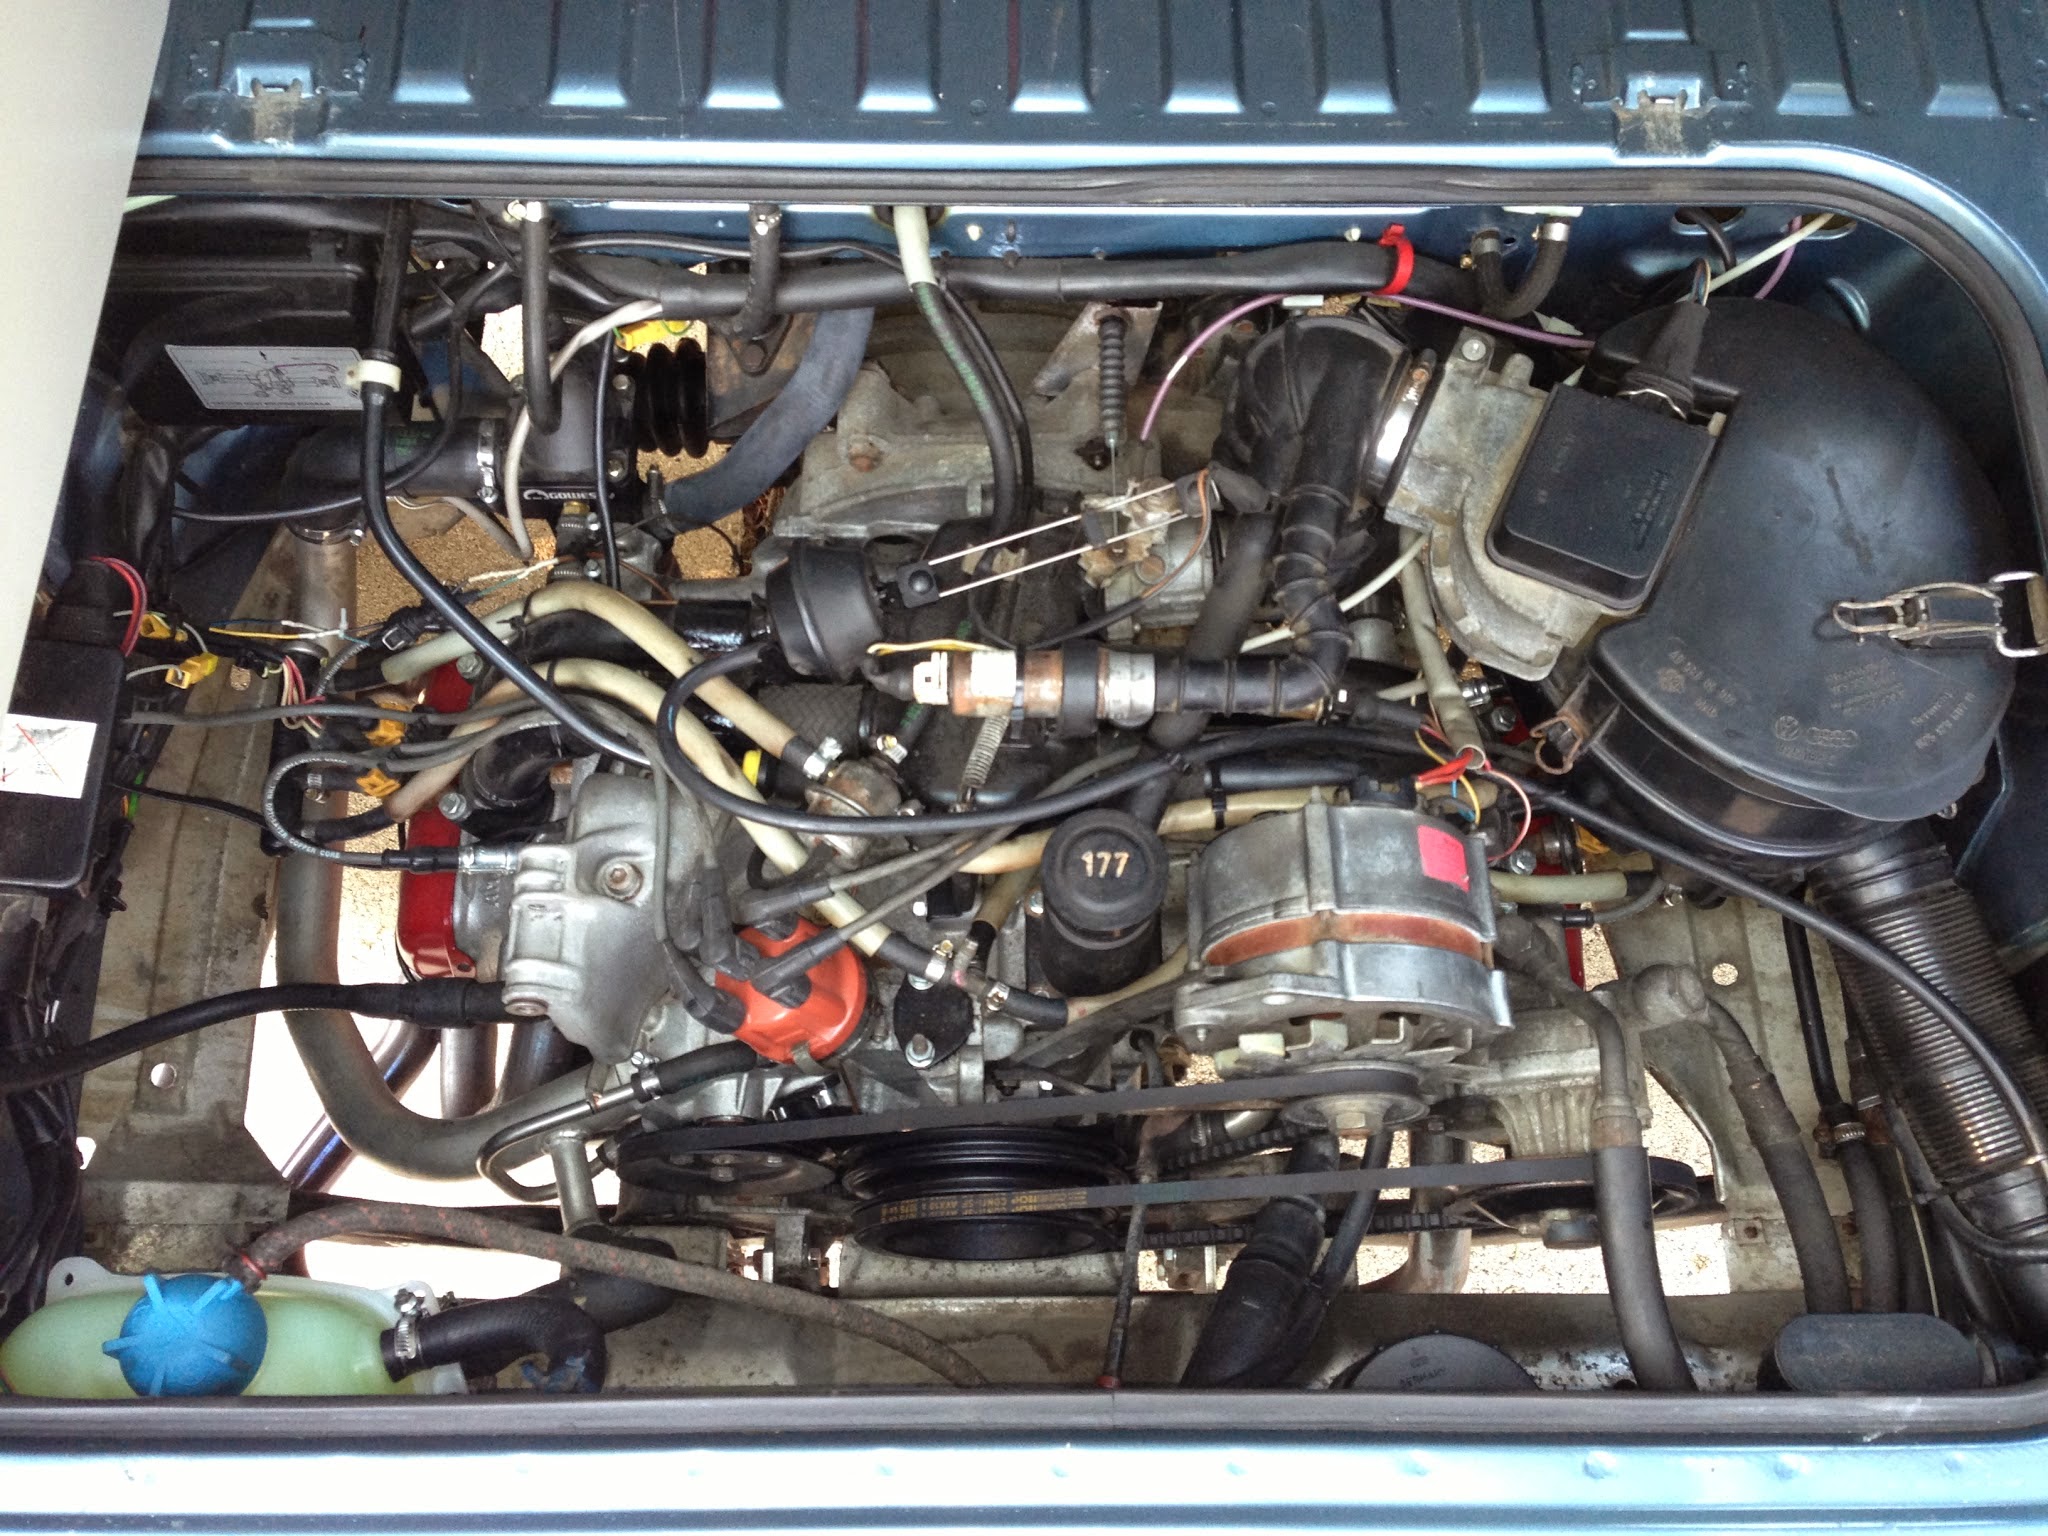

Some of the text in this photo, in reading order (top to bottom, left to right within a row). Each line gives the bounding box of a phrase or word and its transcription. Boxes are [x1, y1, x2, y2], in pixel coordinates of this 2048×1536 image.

[289, 838, 316, 853] COPPER
[320, 850, 340, 859] CORE
[1081, 851, 1129, 877] 177
